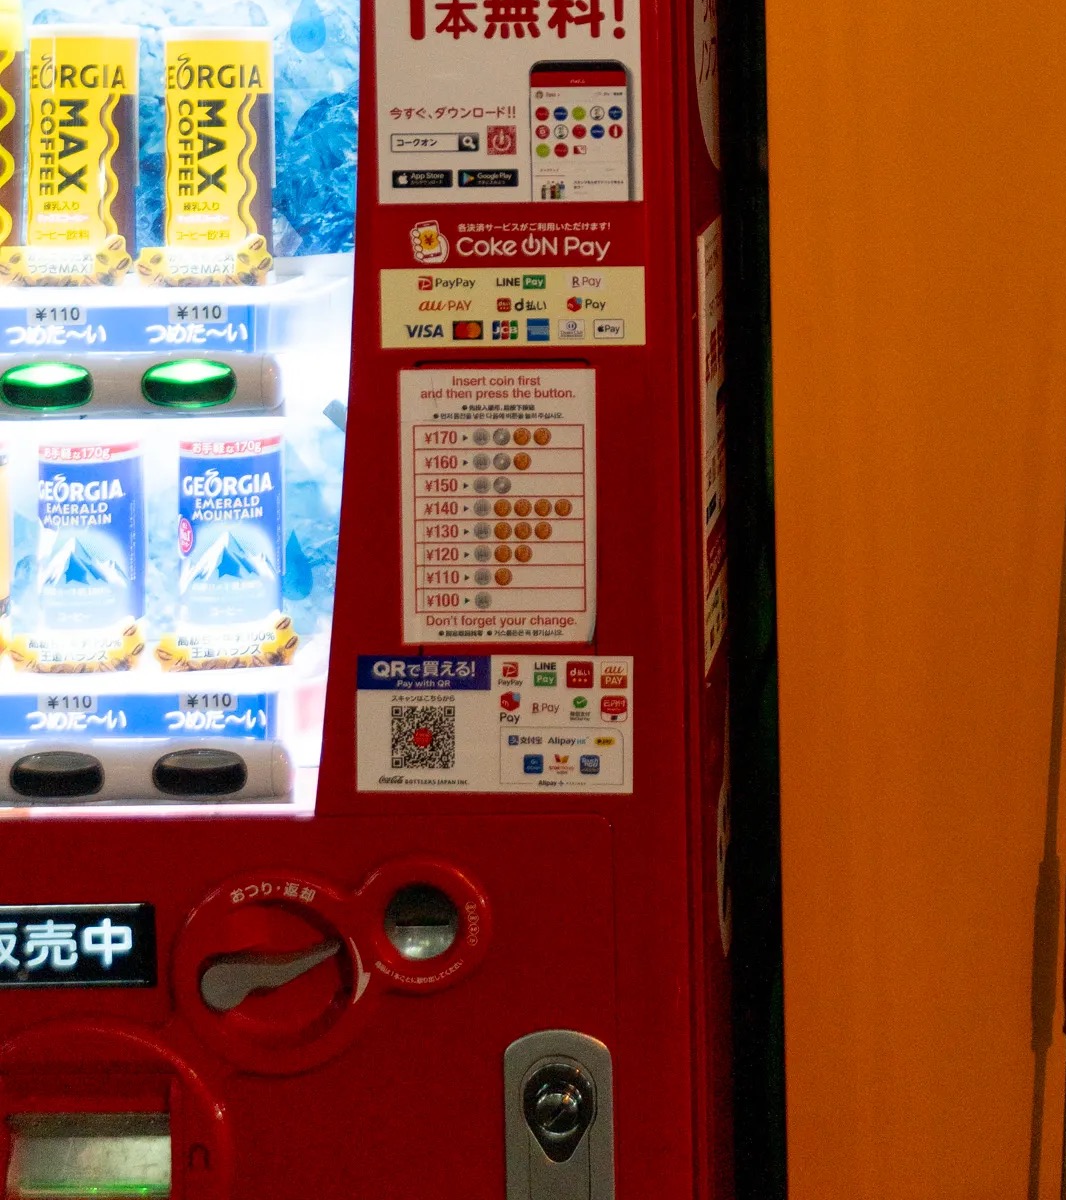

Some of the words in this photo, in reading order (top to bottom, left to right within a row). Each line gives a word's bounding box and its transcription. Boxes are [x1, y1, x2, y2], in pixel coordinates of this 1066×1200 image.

[39, 99, 56, 196] COFFEE
[58, 98, 90, 195] MAX
[178, 99, 195, 196] COFFEE
[197, 98, 228, 195] MAX
[396, 138, 438, 147] コークオン
[411, 172, 425, 181] App
[477, 173, 499, 181] Google
[500, 173, 513, 181] Play
[457, 222, 611, 232] 各決済サービスがご利用いただけます!
[456, 234, 517, 256] Coke
[521, 233, 558, 256] ON
[564, 235, 611, 261] Pay
[435, 277, 476, 289] PayPay
[496, 278, 520, 287] LINE
[525, 278, 544, 288] Pay
[582, 276, 602, 287] Pay
[418, 300, 446, 311] au
[448, 300, 472, 311] PAY
[515, 298, 547, 312] d払い
[585, 299, 606, 311] Pay
[35, 307, 80, 321] ¥110
[177, 305, 222, 320] ¥110
[406, 324, 444, 338] VISA
[492, 323, 519, 337] JCB
[604, 324, 620, 334] Pay
[452, 375, 485, 386] Insert
[489, 375, 514, 386] coin
[518, 375, 541, 386] first
[420, 388, 442, 399] and
[446, 388, 472, 398] then
[476, 389, 509, 400] press
[512, 388, 531, 398] the
[534, 387, 576, 398] button.
[424, 430, 458, 445] ¥170
[424, 456, 458, 469] ¥160
[183, 468, 274, 497] GEORGIA
[425, 478, 458, 492] ¥150
[46, 501, 109, 515] EMERALD
[195, 496, 260, 510] EMERALD
[424, 501, 459, 515] ¥140
[43, 513, 112, 527] MOUNTAIN
[191, 507, 264, 522] MOUNTAIN
[426, 524, 459, 538] ¥130
[426, 547, 459, 561] ¥120
[426, 570, 460, 584] ¥110
[426, 593, 460, 607] ¥100
[426, 615, 457, 626] Don't
[461, 615, 496, 628] forget
[500, 617, 526, 628] your
[530, 615, 577, 628] change.
[373, 660, 476, 678] QRで買える!
[534, 662, 556, 670] LINE
[397, 679, 413, 688] Pay
[498, 679, 523, 687] PayPay
[536, 675, 555, 685] Pay
[47, 694, 92, 709] ¥110
[187, 693, 232, 708] ¥110
[542, 702, 560, 714] Pay
[499, 712, 520, 724] Pay
[229, 881, 317, 903] おつり・返却
